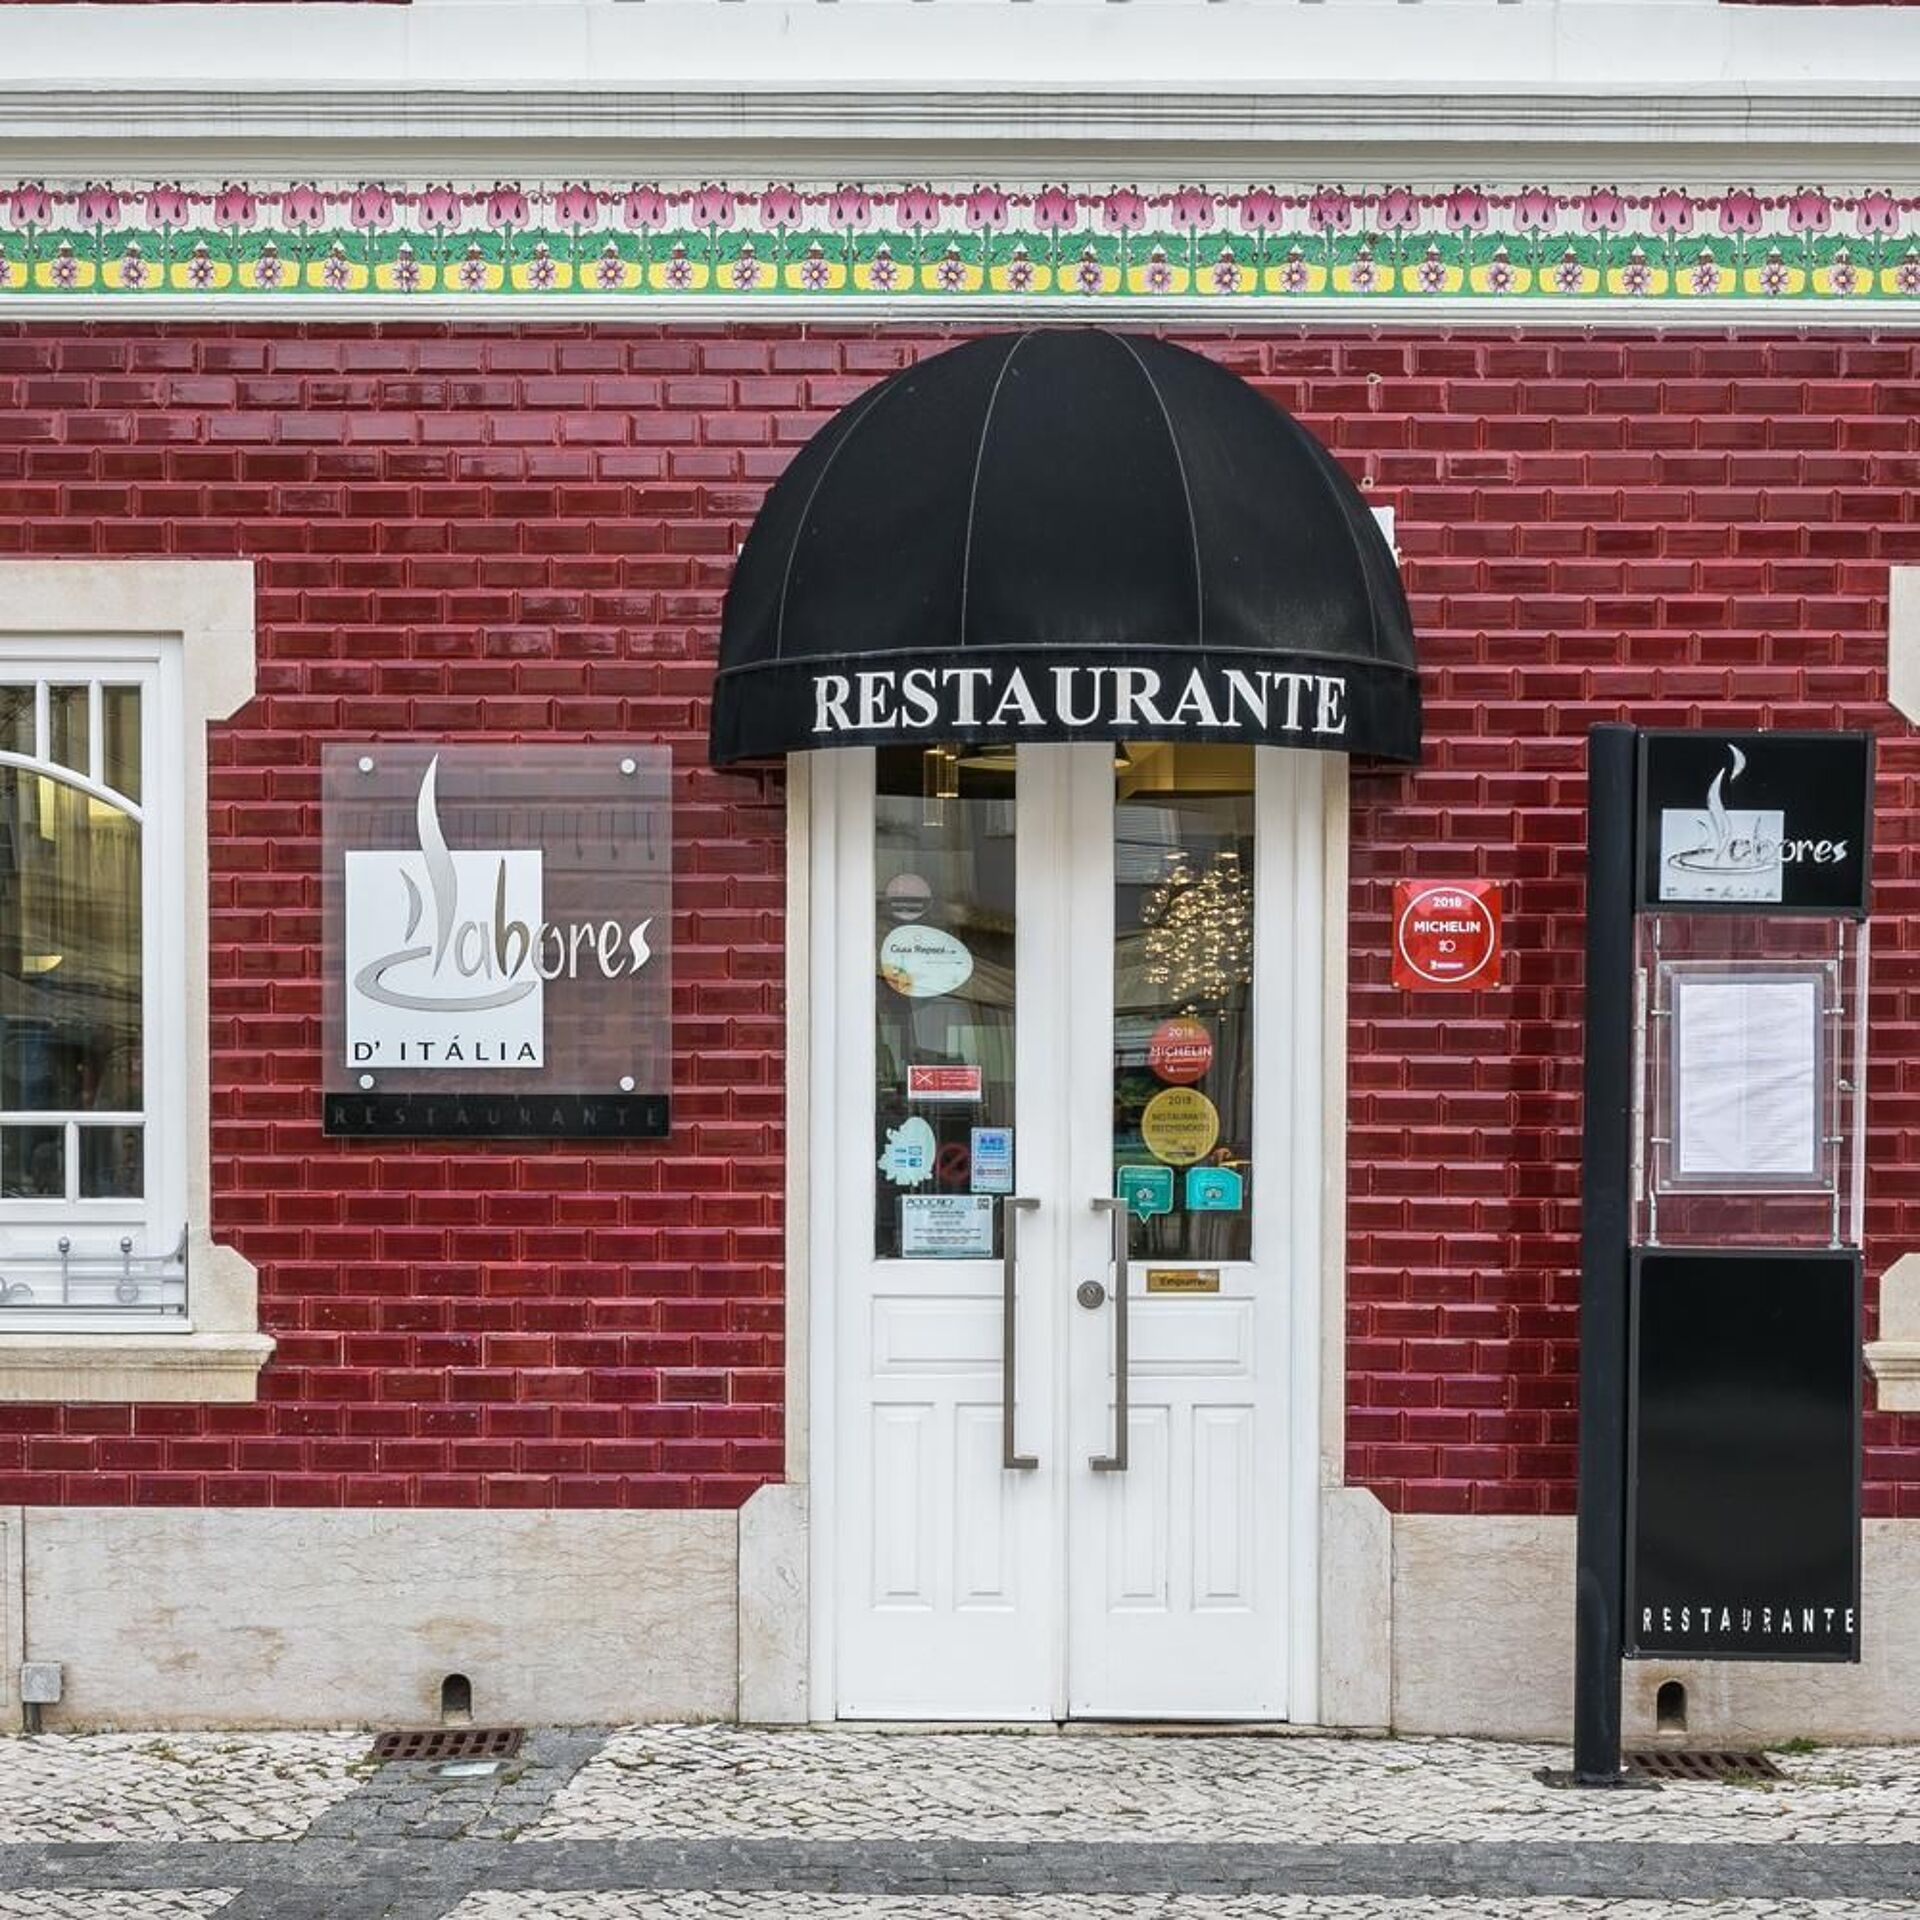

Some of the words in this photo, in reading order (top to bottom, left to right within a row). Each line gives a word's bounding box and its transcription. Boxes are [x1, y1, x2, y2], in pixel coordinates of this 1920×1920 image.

[811, 666, 1348, 735] RESTAURANTE
[1432, 896, 1463, 909] 2018
[1413, 920, 1481, 934] MICHELIN
[354, 1041, 381, 1062] D'
[400, 1034, 538, 1062] ITÁLIA
[1150, 1045, 1213, 1057] MICHELIN
[334, 1106, 659, 1125] RESTAURANTE
[1642, 1606, 1854, 1634] RESTAURANTE
